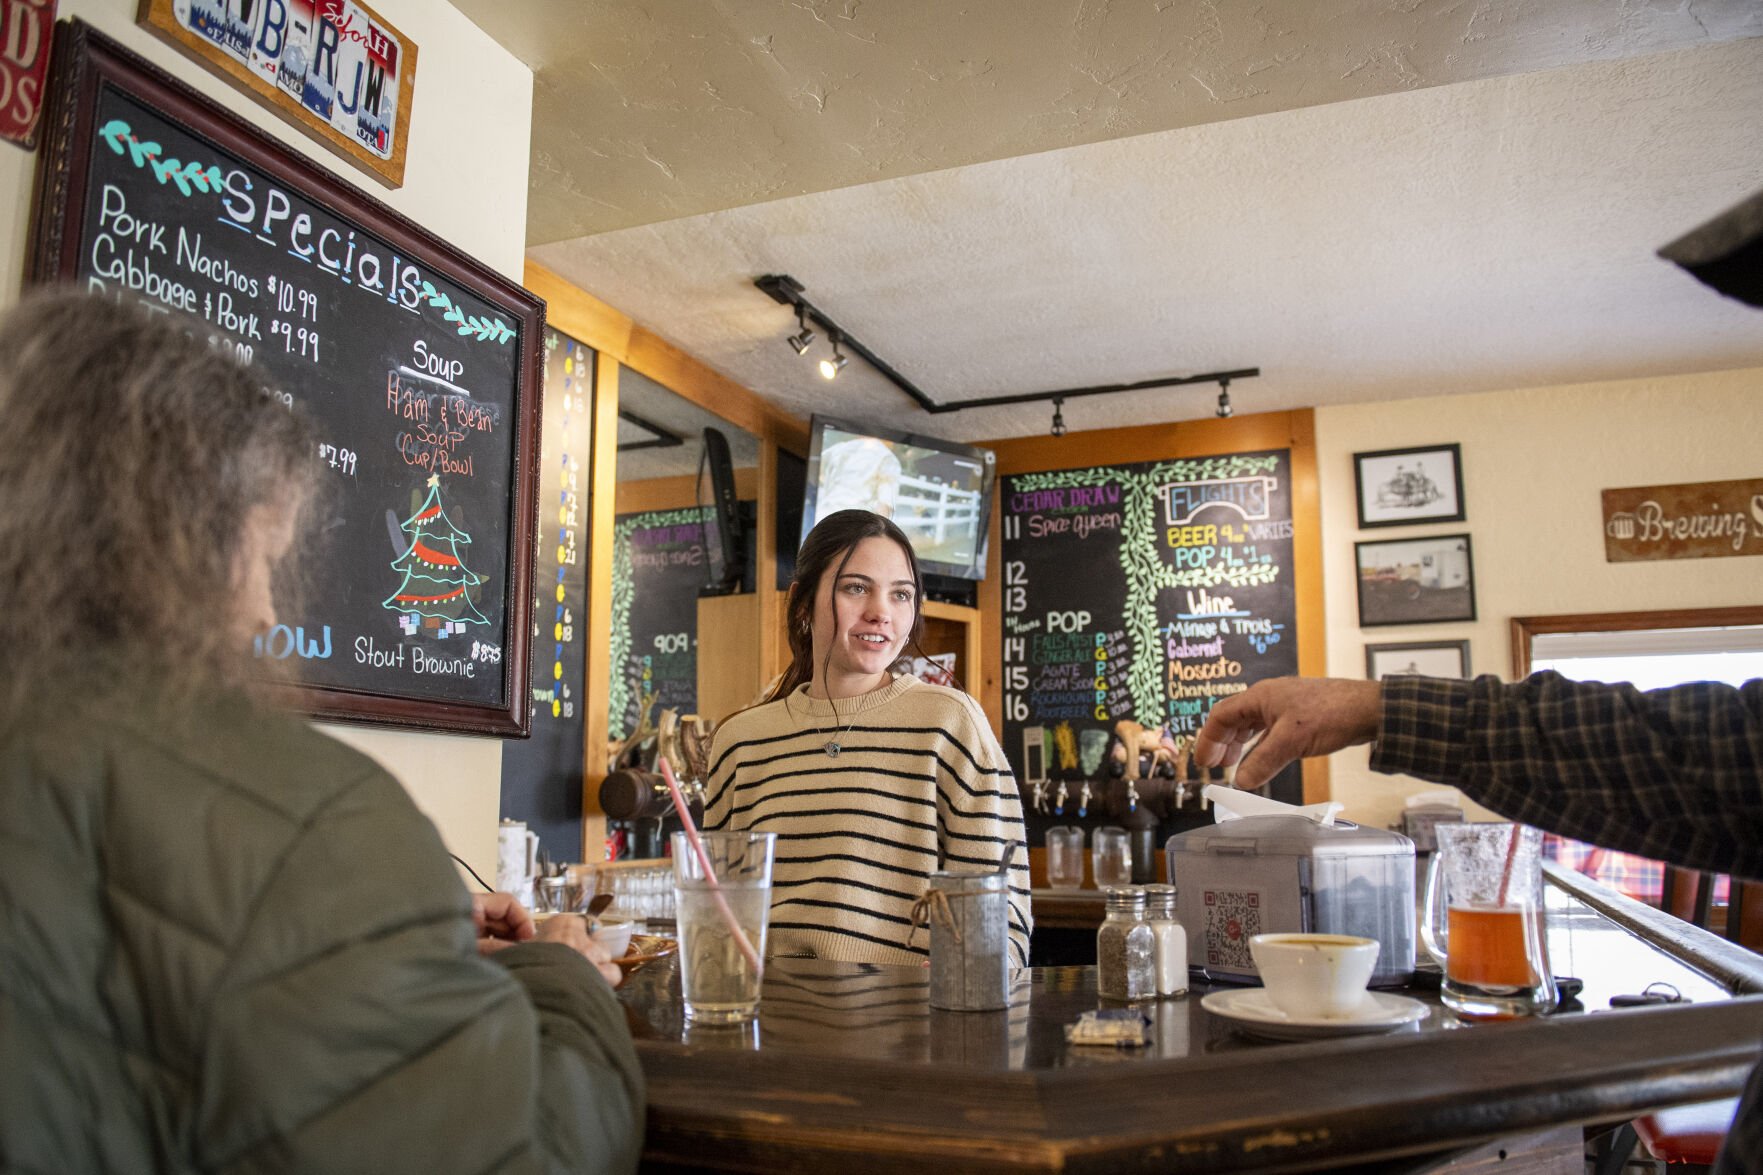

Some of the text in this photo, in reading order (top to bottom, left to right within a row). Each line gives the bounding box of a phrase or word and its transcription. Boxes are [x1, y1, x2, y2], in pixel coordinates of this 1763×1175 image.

[100, 185, 167, 255] Pork
[176, 226, 259, 298] Nachos
[267, 275, 318, 322] $10.99
[92, 233, 198, 313] Cabbage
[217, 292, 262, 341] Pork
[270, 319, 319, 363] $9.99
[413, 339, 464, 382] Soup
[387, 373, 429, 423] Ham
[455, 399, 492, 433] Bean
[416, 423, 465, 453] Soup
[319, 442, 357, 476] $7.99
[1170, 483, 1265, 520] FLIGHTS
[1005, 514, 1020, 540] 11
[1166, 524, 1218, 549] BEER
[1636, 500, 1747, 550] Brewing
[1175, 545, 1216, 569] POP
[1006, 560, 1029, 586] 12
[1005, 586, 1027, 613] 13
[1186, 588, 1238, 616] Wine
[1046, 610, 1092, 634] POP
[354, 636, 475, 679] Stout Brownie
[1004, 637, 1026, 663] 14
[1005, 666, 1030, 691] 15
[1005, 693, 1030, 722] 16
